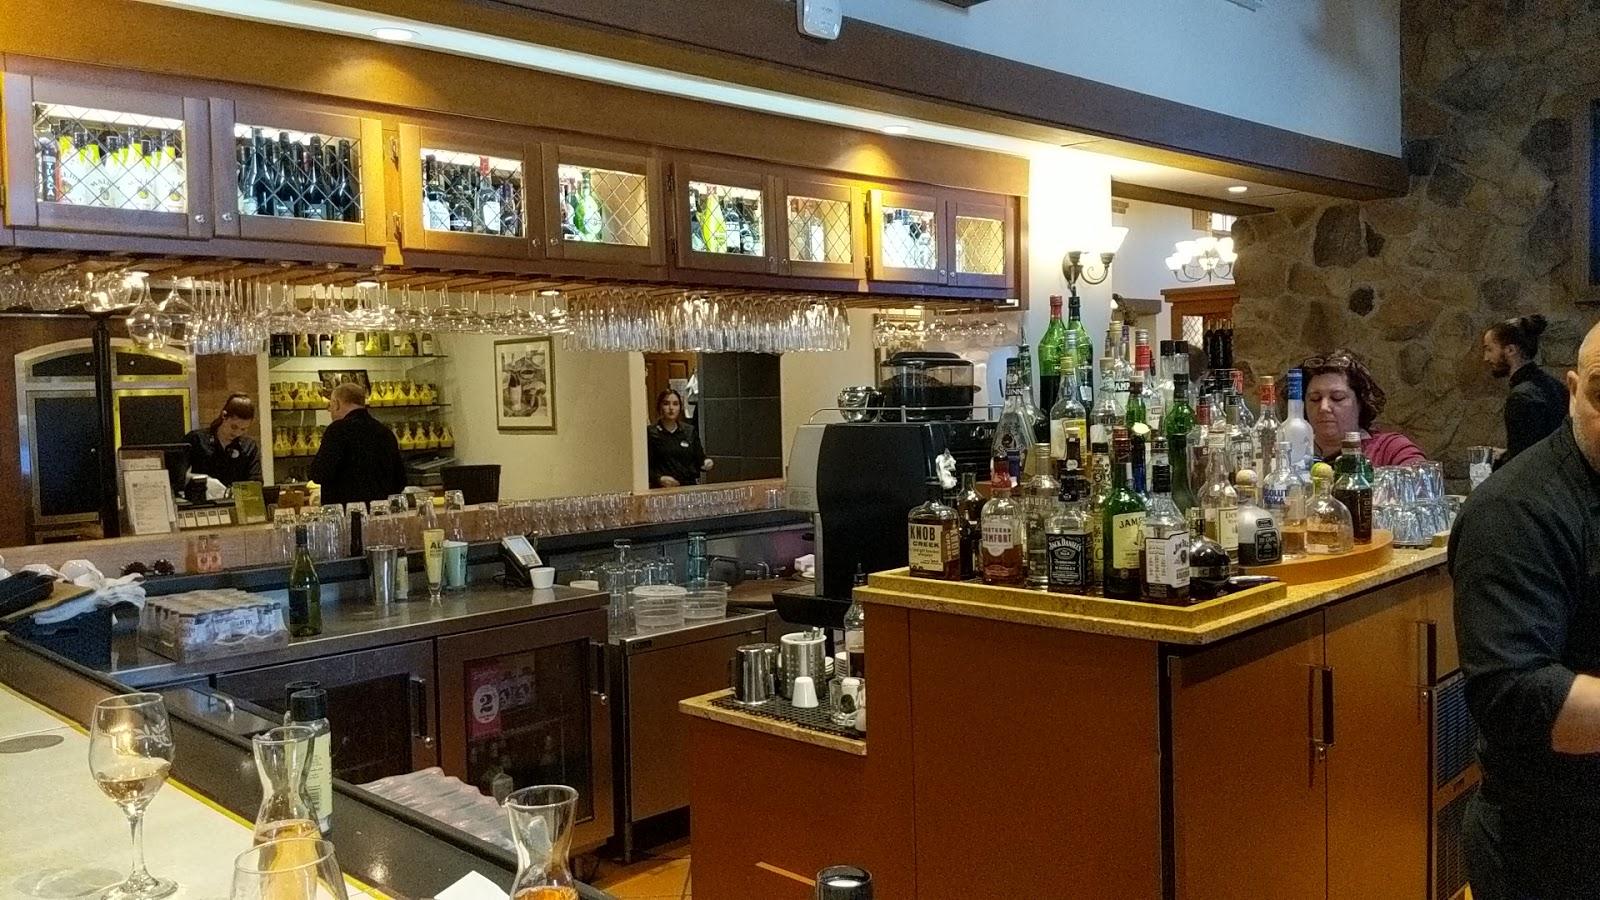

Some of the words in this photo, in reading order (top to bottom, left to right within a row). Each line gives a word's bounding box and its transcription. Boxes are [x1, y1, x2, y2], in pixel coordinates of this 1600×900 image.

[46, 161, 55, 196] TUACA
[910, 525, 936, 541] KNOB
[912, 540, 940, 549] CREEK
[479, 693, 494, 714] 2
